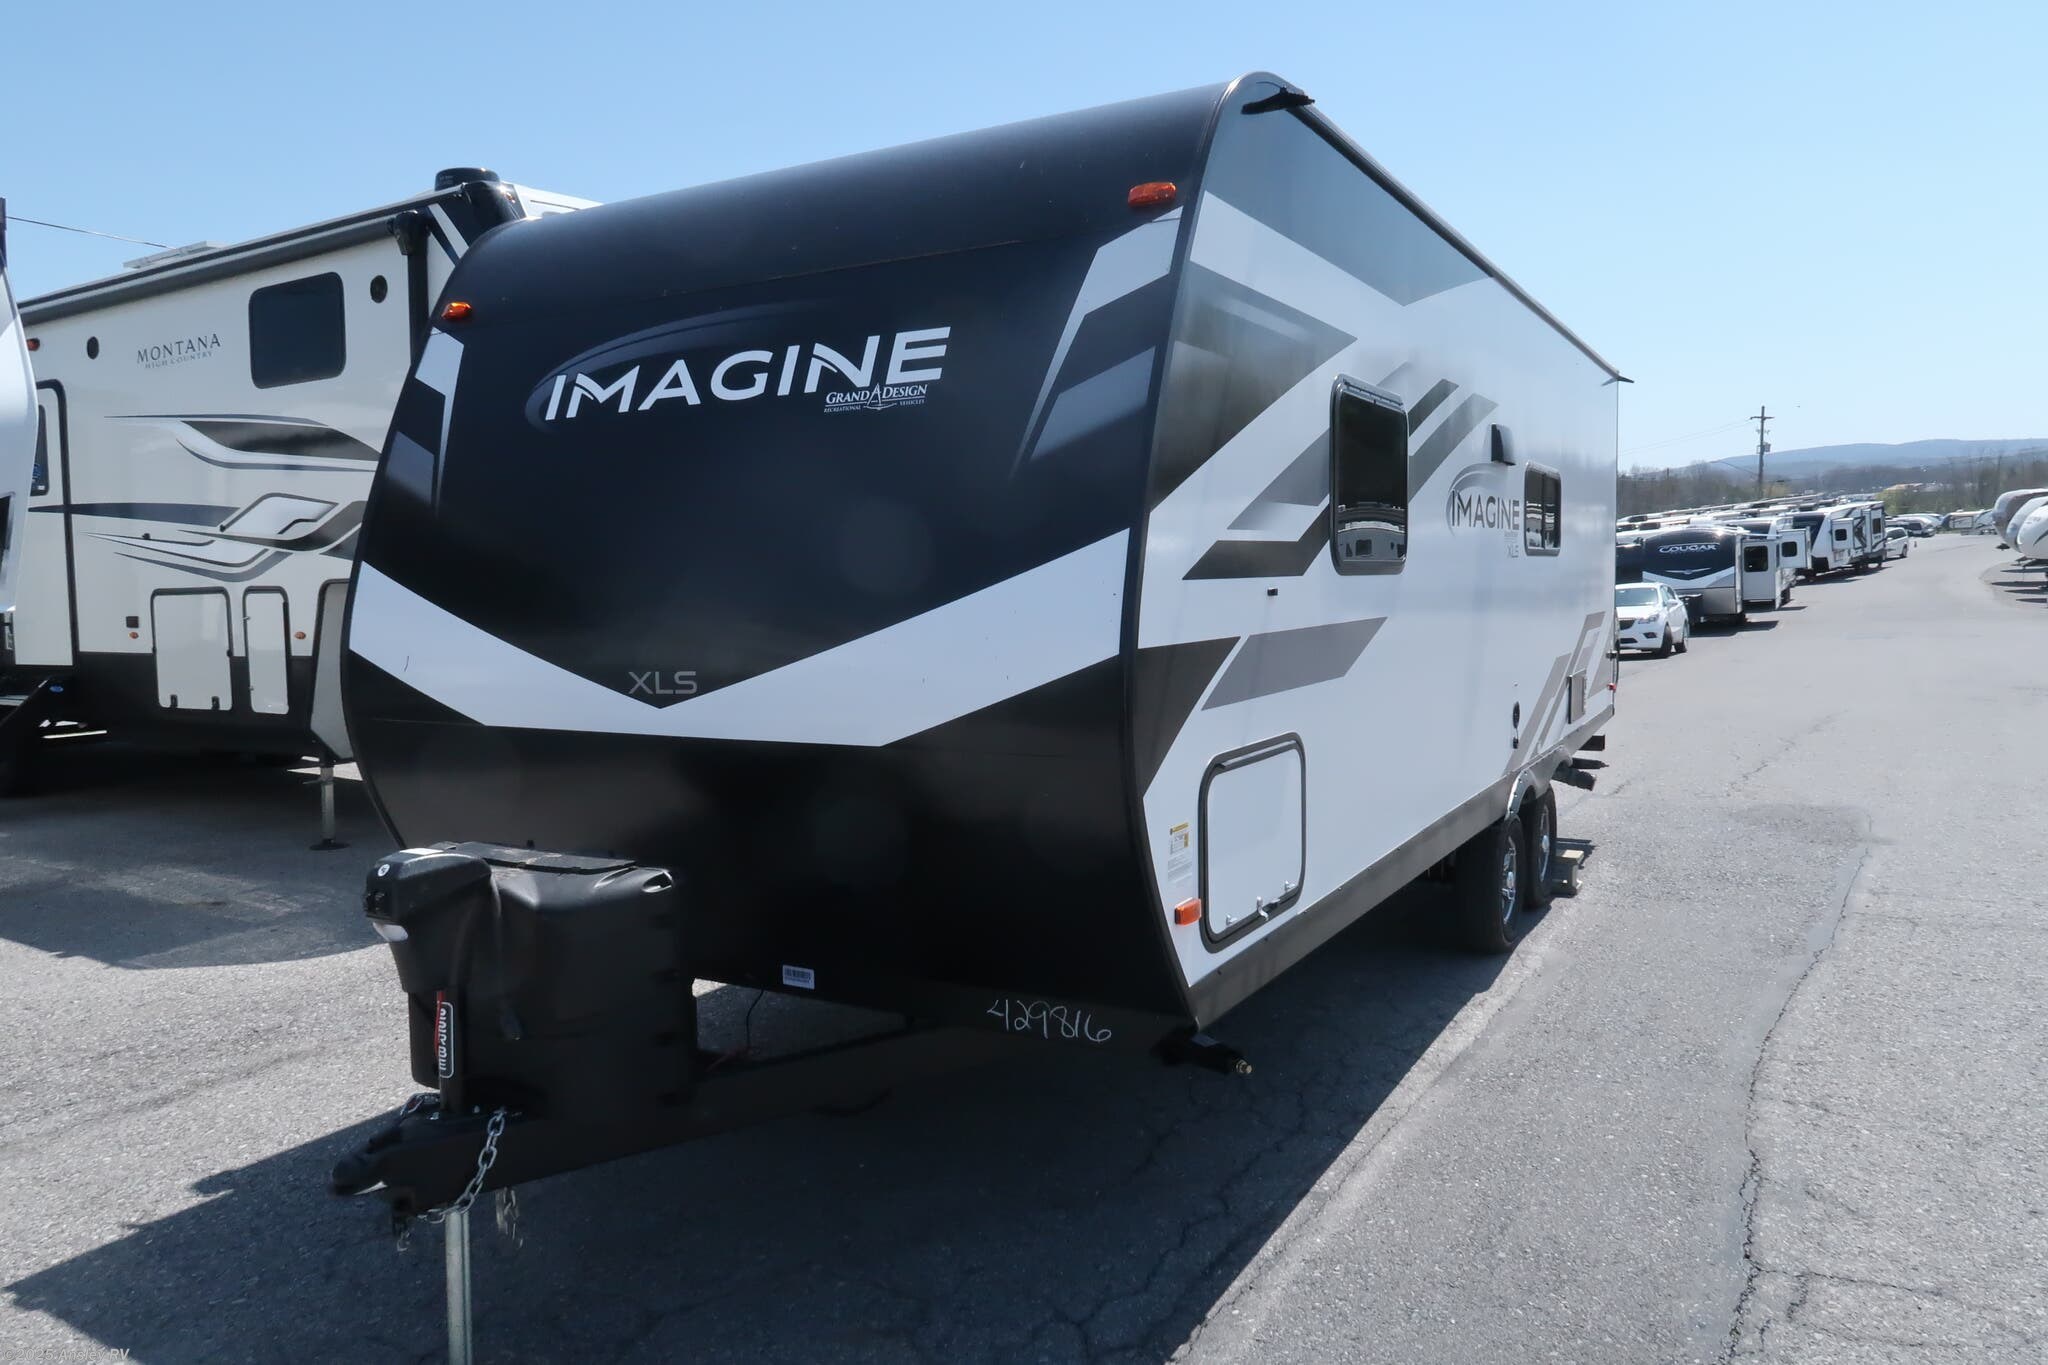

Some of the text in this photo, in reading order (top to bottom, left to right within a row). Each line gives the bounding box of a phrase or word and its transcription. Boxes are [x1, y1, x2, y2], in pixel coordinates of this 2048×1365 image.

[137, 333, 221, 365] MONTANA
[545, 326, 951, 421] IMAGINE
[825, 384, 928, 404] GRAND DESIGN
[1451, 490, 1520, 530] IMAGINE
[1658, 544, 1717, 554] COUGAR
[628, 671, 697, 695] XLS
[986, 1000, 1112, 1042] 429816
